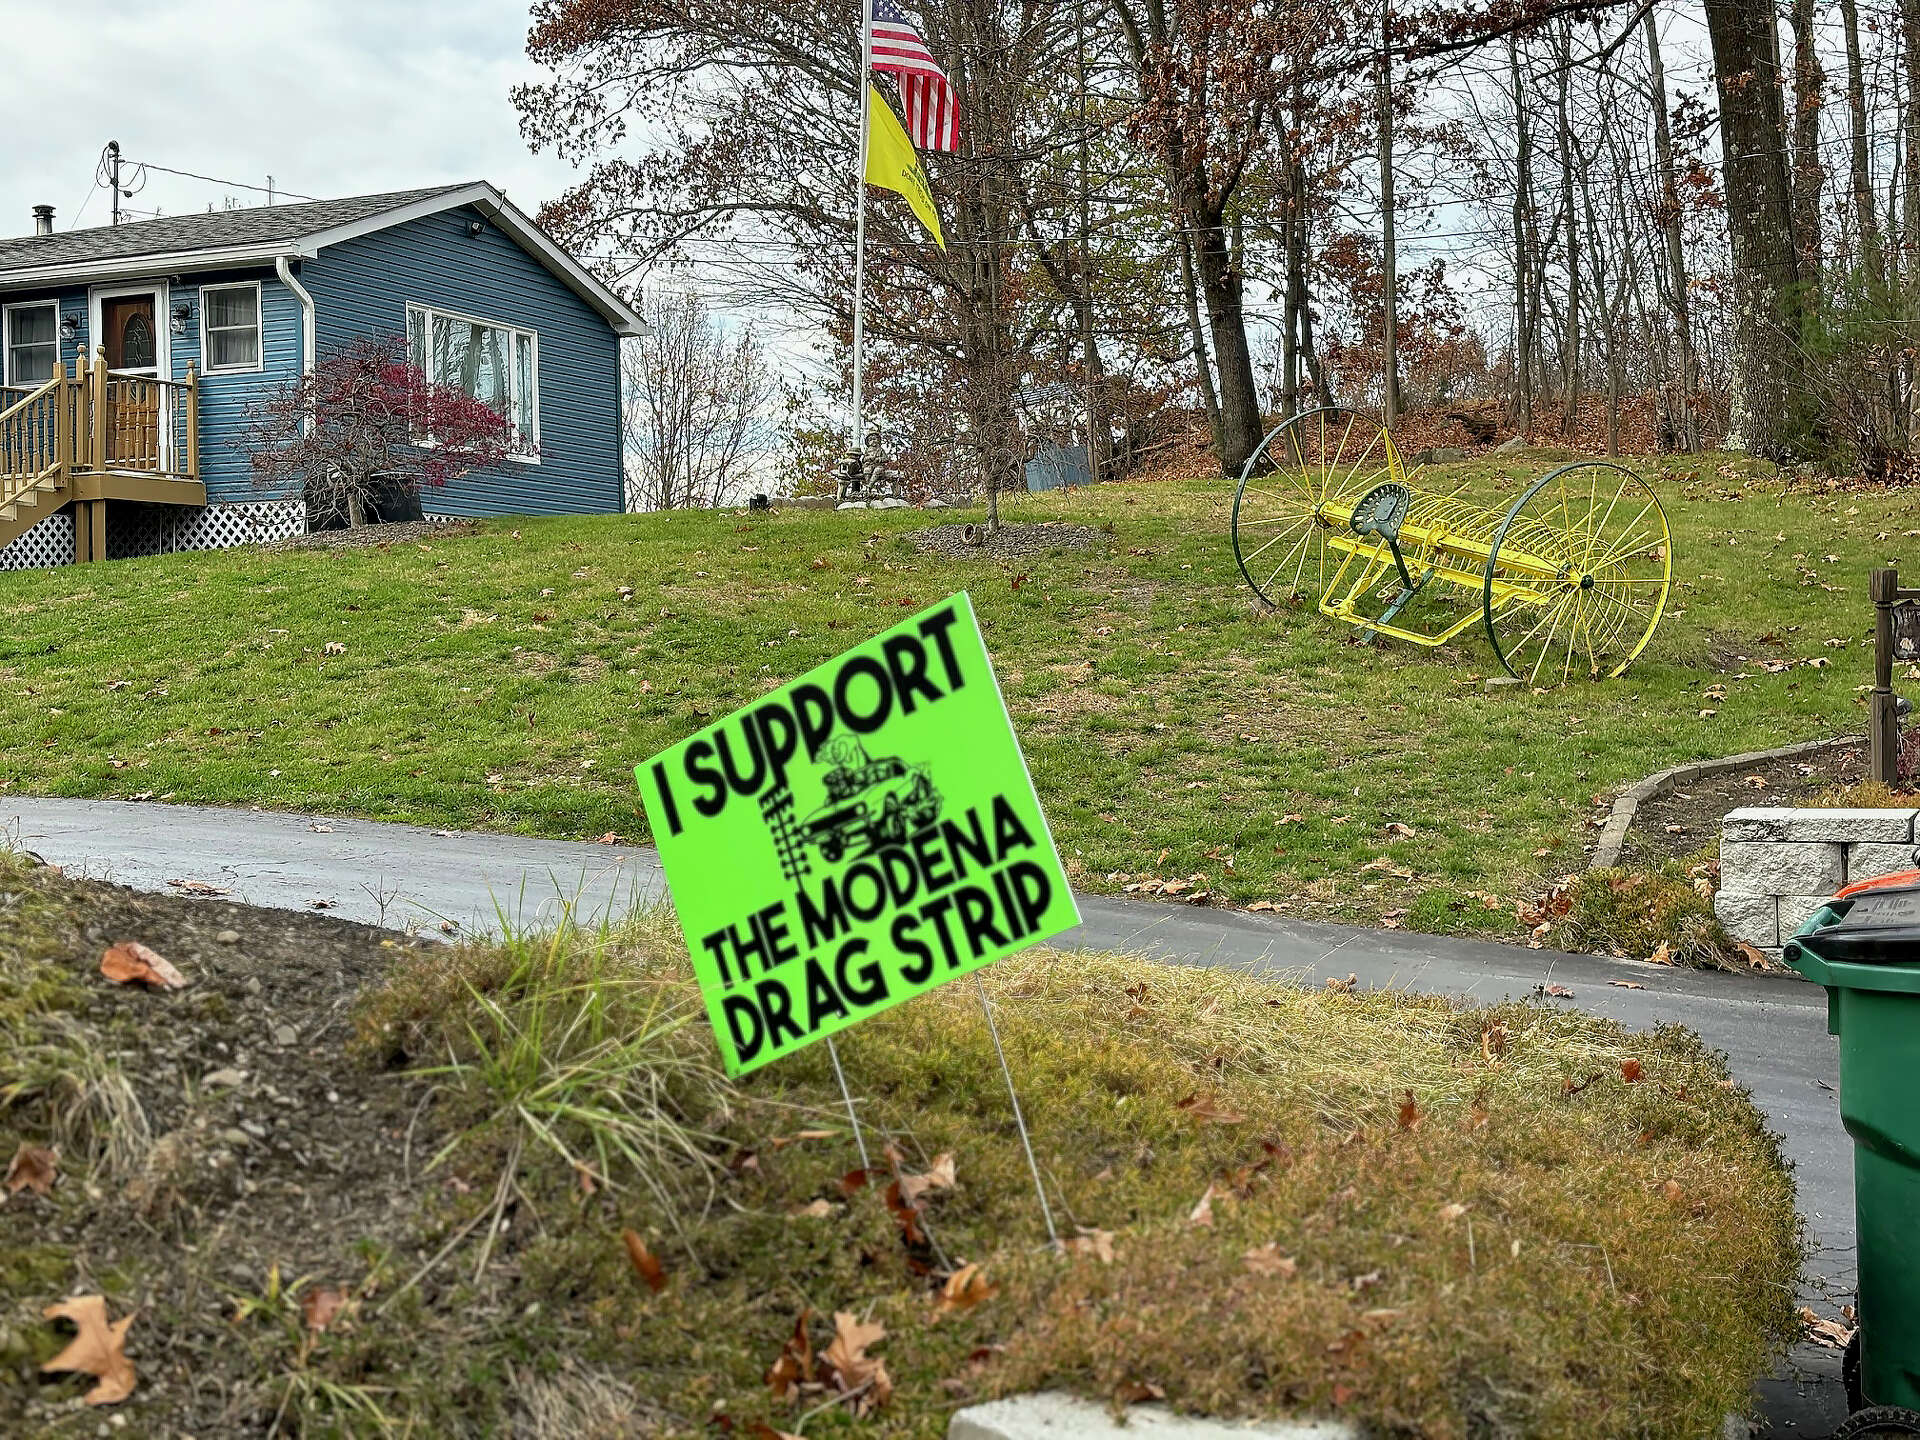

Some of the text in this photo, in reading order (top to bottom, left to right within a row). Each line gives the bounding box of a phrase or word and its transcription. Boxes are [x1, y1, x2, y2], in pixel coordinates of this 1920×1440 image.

[652, 606, 965, 836] I SUPPORT
[702, 794, 1036, 990] THE MODENA
[722, 861, 1052, 1064] DRAG STRIP
